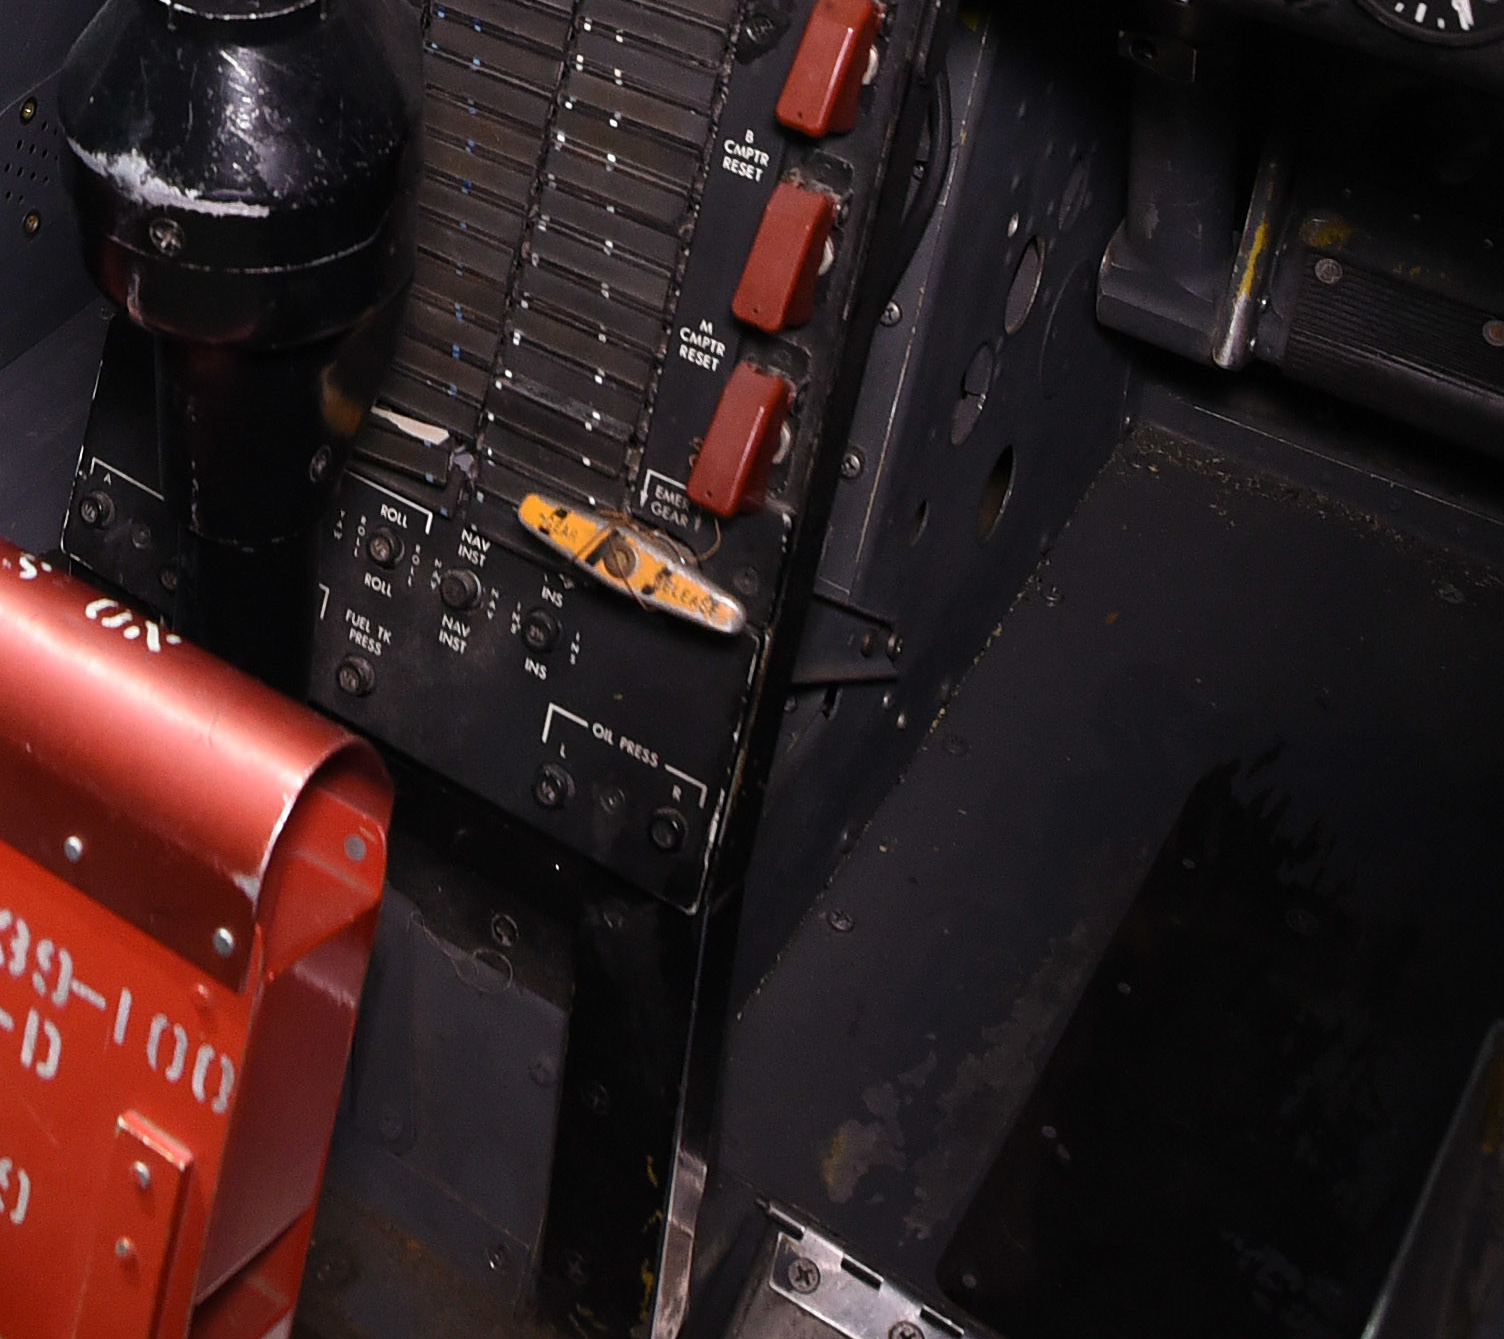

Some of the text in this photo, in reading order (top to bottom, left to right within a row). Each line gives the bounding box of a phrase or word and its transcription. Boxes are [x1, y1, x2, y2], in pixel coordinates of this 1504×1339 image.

[381, 504, 407, 528] ROLL
[442, 614, 470, 637] NAV
[439, 630, 466, 653] INST
[593, 723, 658, 767] OIL PRESS
